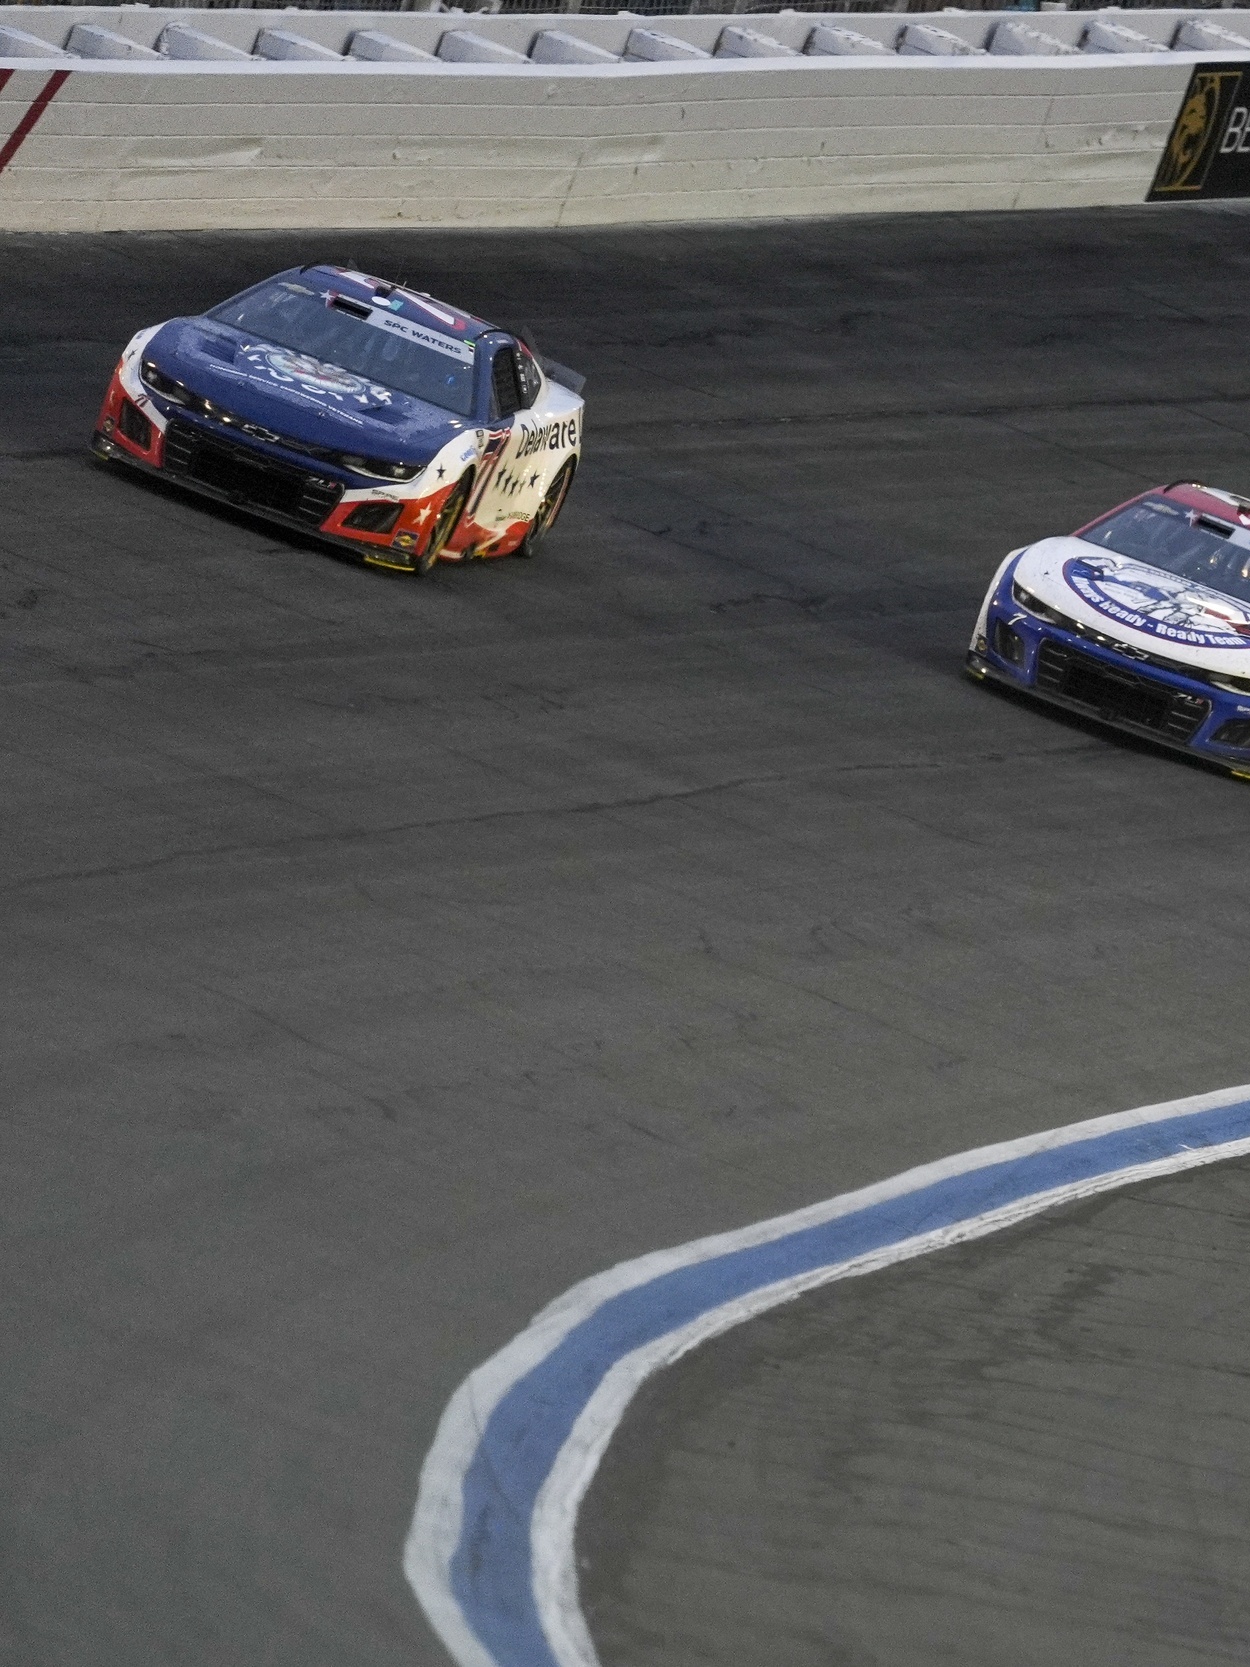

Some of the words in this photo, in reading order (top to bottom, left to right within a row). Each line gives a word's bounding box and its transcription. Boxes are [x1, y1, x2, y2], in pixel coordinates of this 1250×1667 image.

[383, 319, 408, 333] SPC
[411, 330, 462, 355] WATERS
[328, 405, 364, 425] VETERANS
[515, 418, 577, 459] Delaware
[1155, 622, 1206, 645] Ready
[1205, 633, 1247, 646] Team
